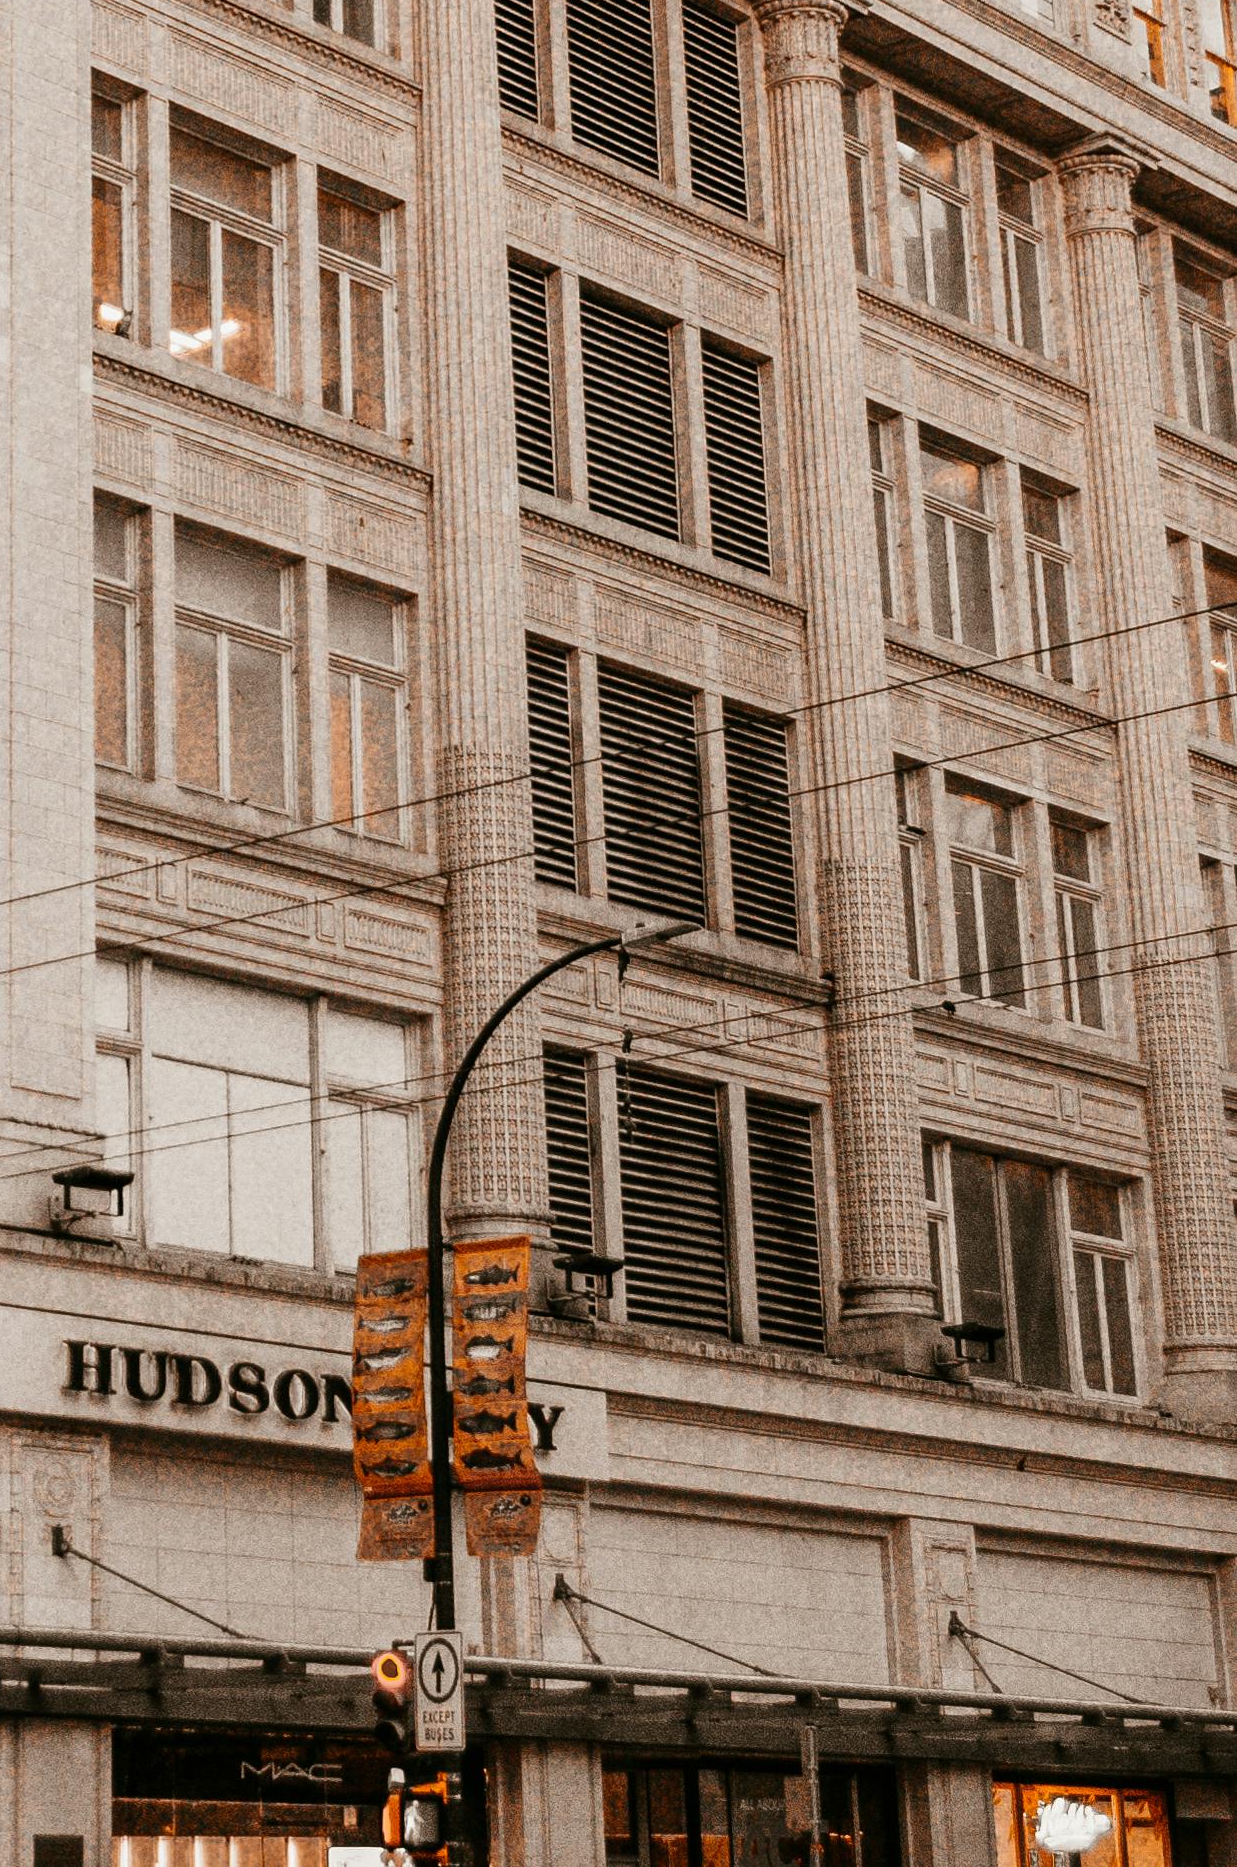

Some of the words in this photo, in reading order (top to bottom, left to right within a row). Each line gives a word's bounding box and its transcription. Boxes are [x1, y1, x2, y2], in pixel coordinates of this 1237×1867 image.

[63, 1339, 352, 1423] HUDSON
[423, 1710, 455, 1724] EXCEPT
[425, 1727, 455, 1741] BUSES
